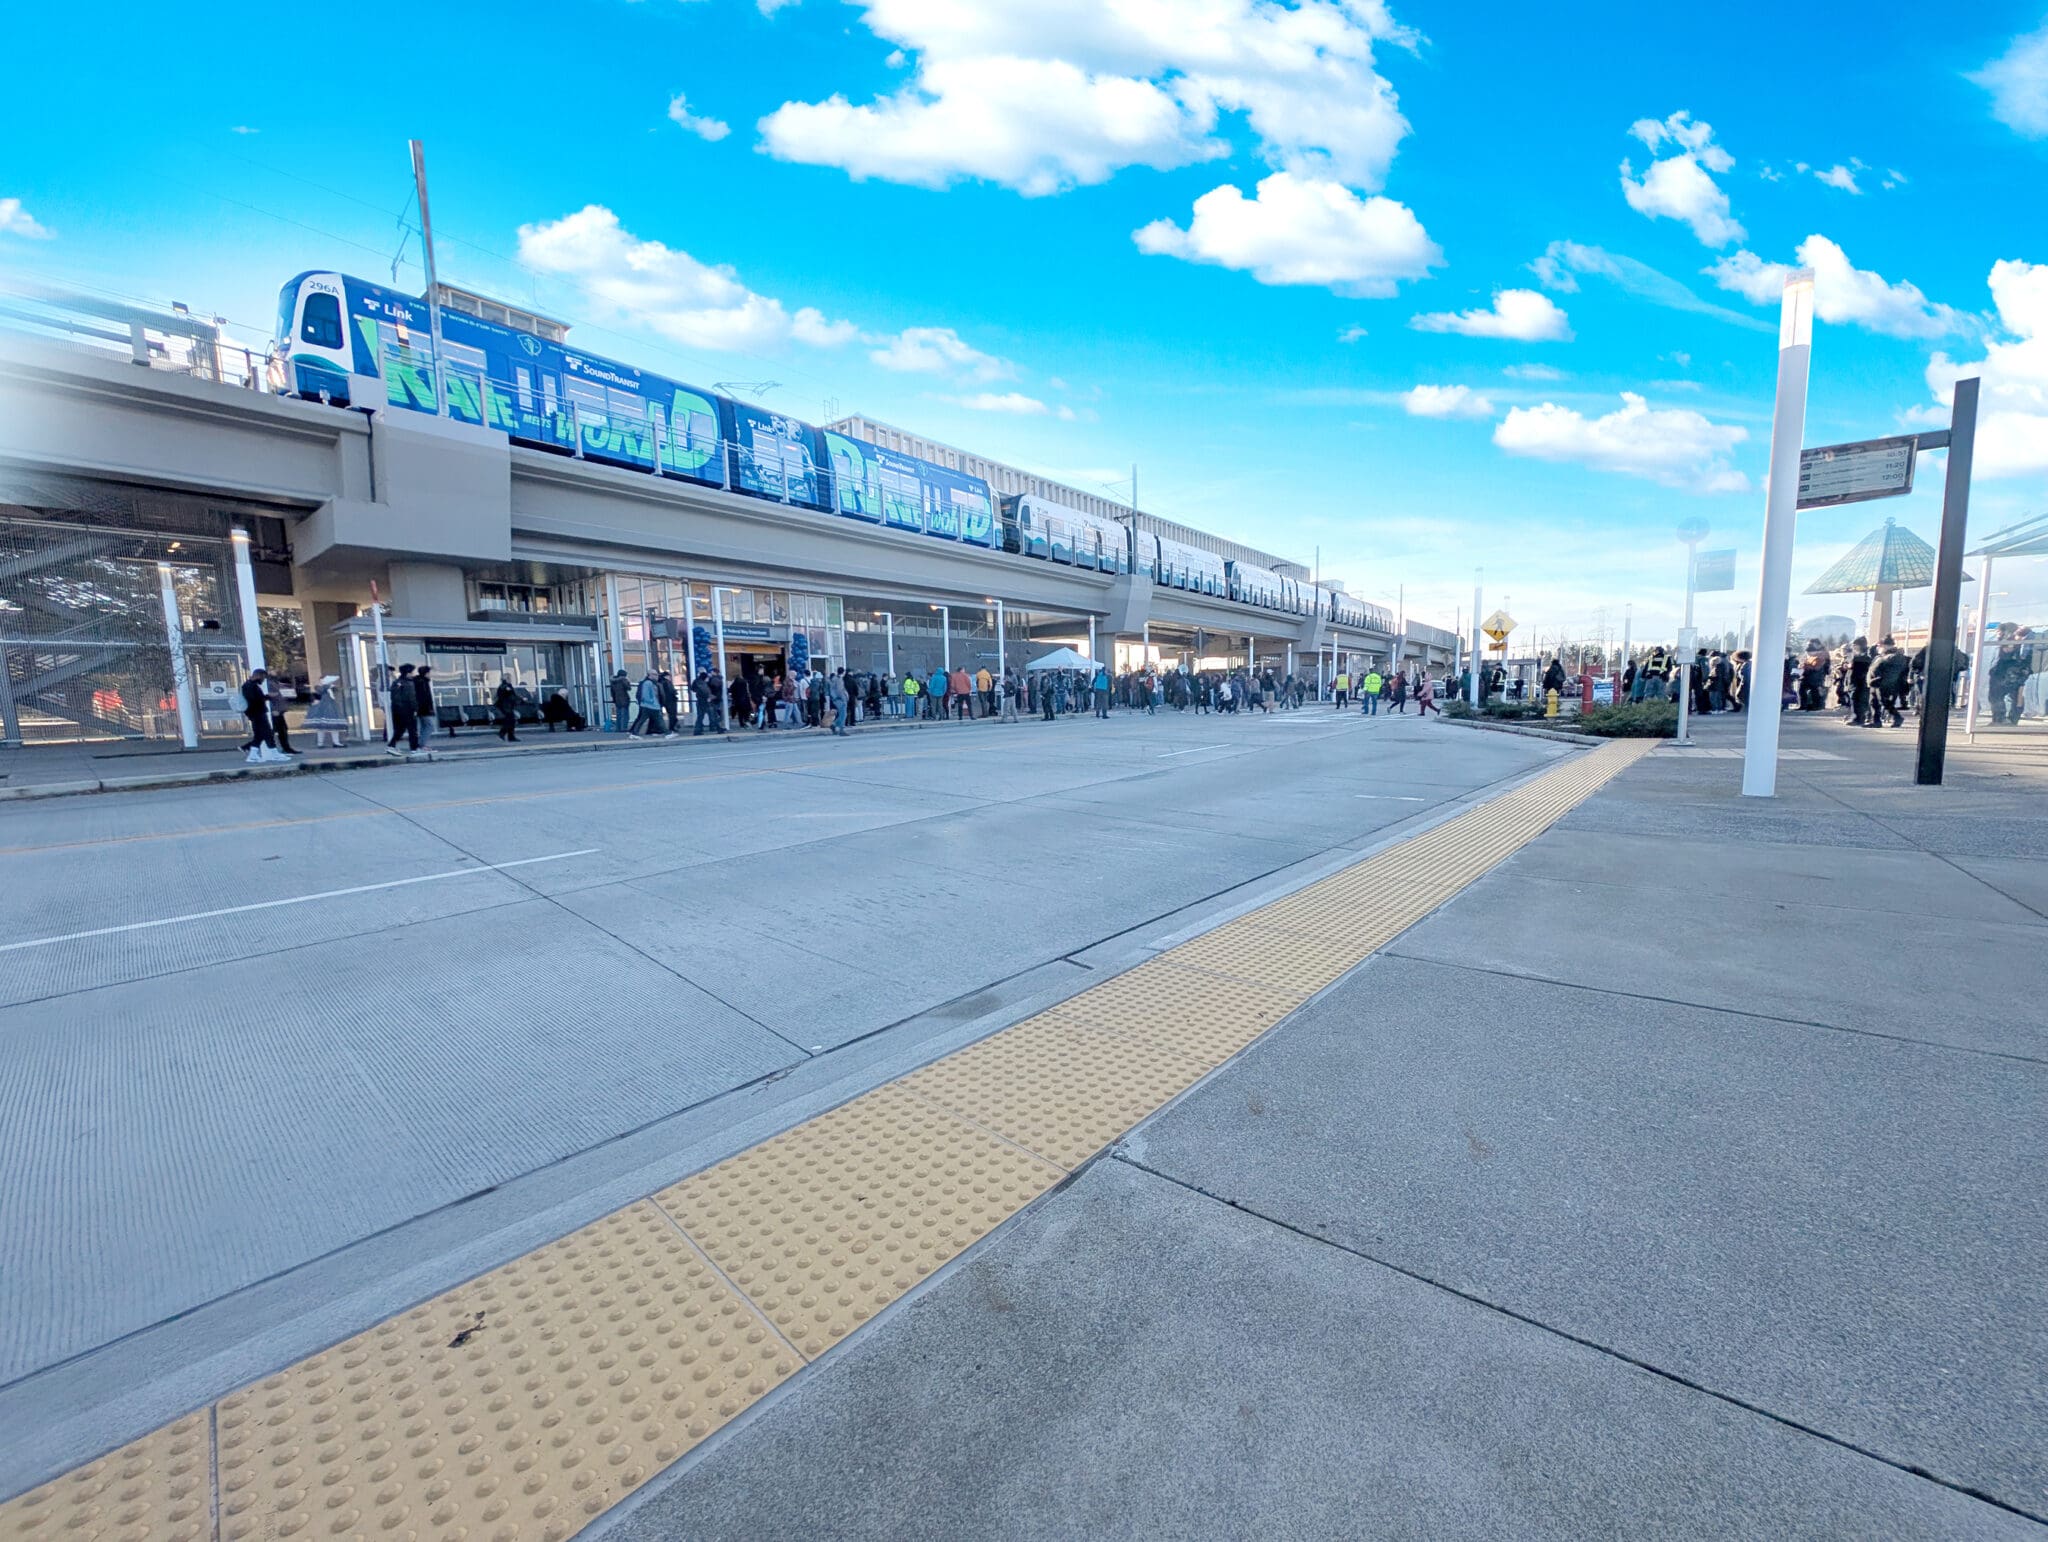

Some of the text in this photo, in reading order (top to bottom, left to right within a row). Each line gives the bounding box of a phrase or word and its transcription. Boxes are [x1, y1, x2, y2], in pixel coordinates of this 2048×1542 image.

[309, 280, 339, 295] 296A
[384, 304, 413, 322] Link
[522, 413, 552, 428] MEETS
[757, 422, 774, 434] Link
